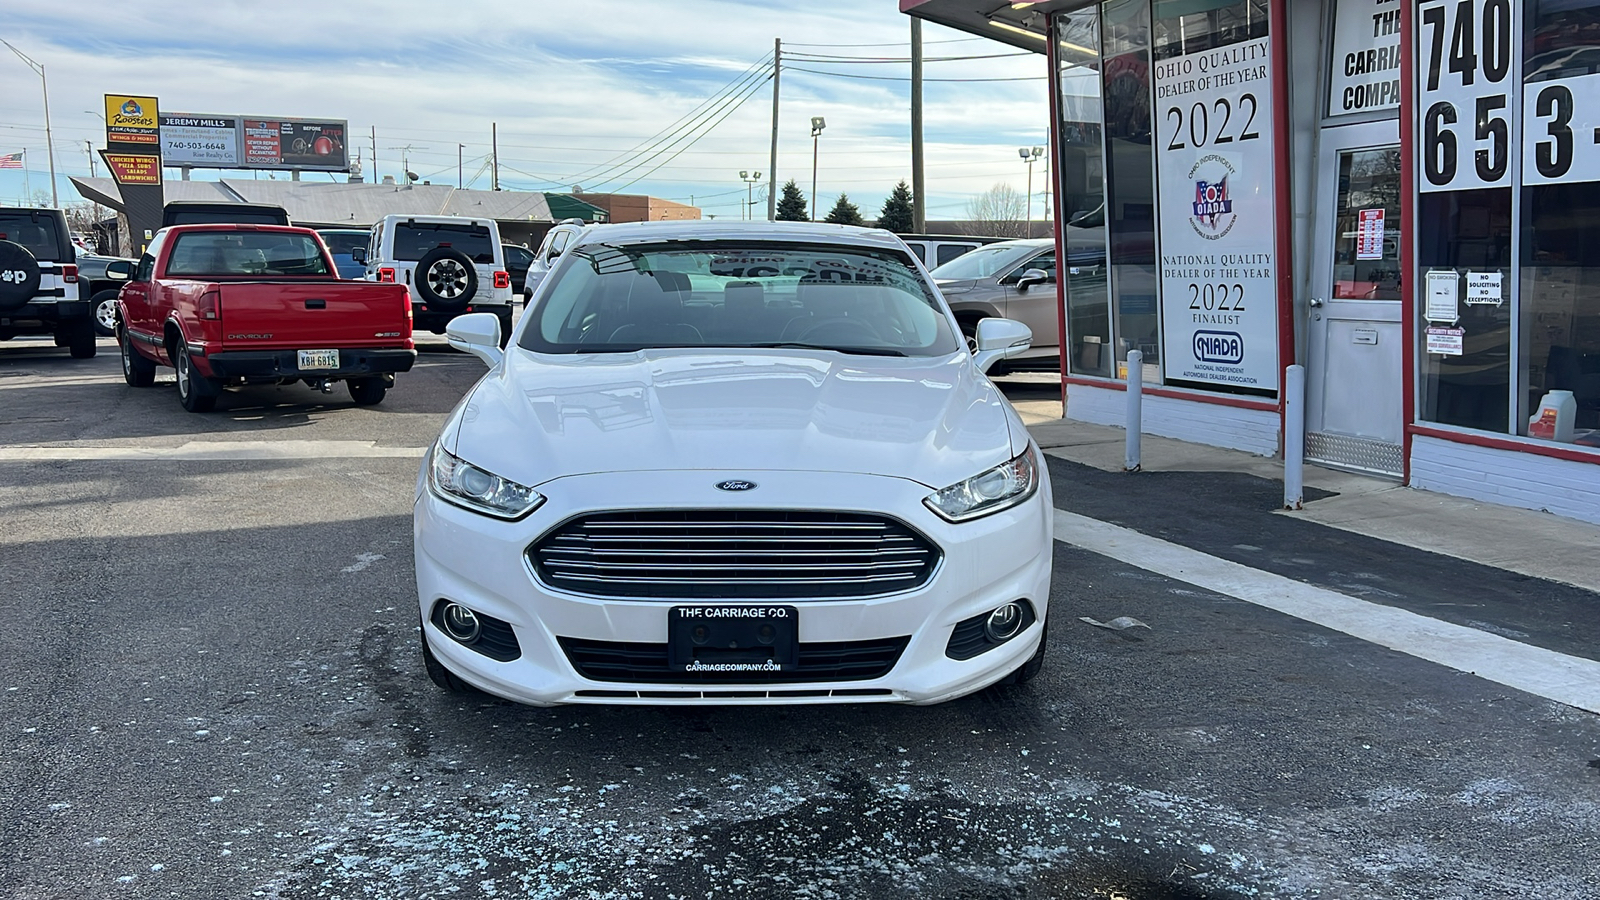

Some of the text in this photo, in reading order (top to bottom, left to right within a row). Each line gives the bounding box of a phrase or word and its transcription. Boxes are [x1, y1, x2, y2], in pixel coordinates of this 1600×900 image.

[1423, 0, 1511, 92] 740
[1156, 42, 1268, 80] OHIO QUALITY
[1158, 65, 1267, 99] DEALER OF THE YEAR
[1342, 79, 1400, 111] COMPA
[112, 114, 154, 126] Roosters
[166, 118, 226, 127] JEREMY MILLS
[1167, 93, 1259, 151] 2022
[168, 142, 226, 150] 740-503-6648
[1188, 154, 1236, 180] OHIO INDEPENDENT
[1197, 203, 1226, 215] OIADA
[1163, 254, 1271, 266] NATIONAL QUALITY
[1165, 268, 1271, 278] DEALER OF THE YEAR
[1188, 283, 1245, 311] 2022
[1192, 314, 1240, 325] FINALIST
[1197, 337, 1238, 357] NIADA
[1194, 364, 1244, 374] NATIONAL INDEPENDENT
[1183, 371, 1208, 379] AUTOMOBILE
[1228, 375, 1258, 384] ASSOCIATION
[679, 608, 789, 618] THE CARRIAGE CO.
[686, 664, 781, 672] CARRIAGECOMPANY.COM
